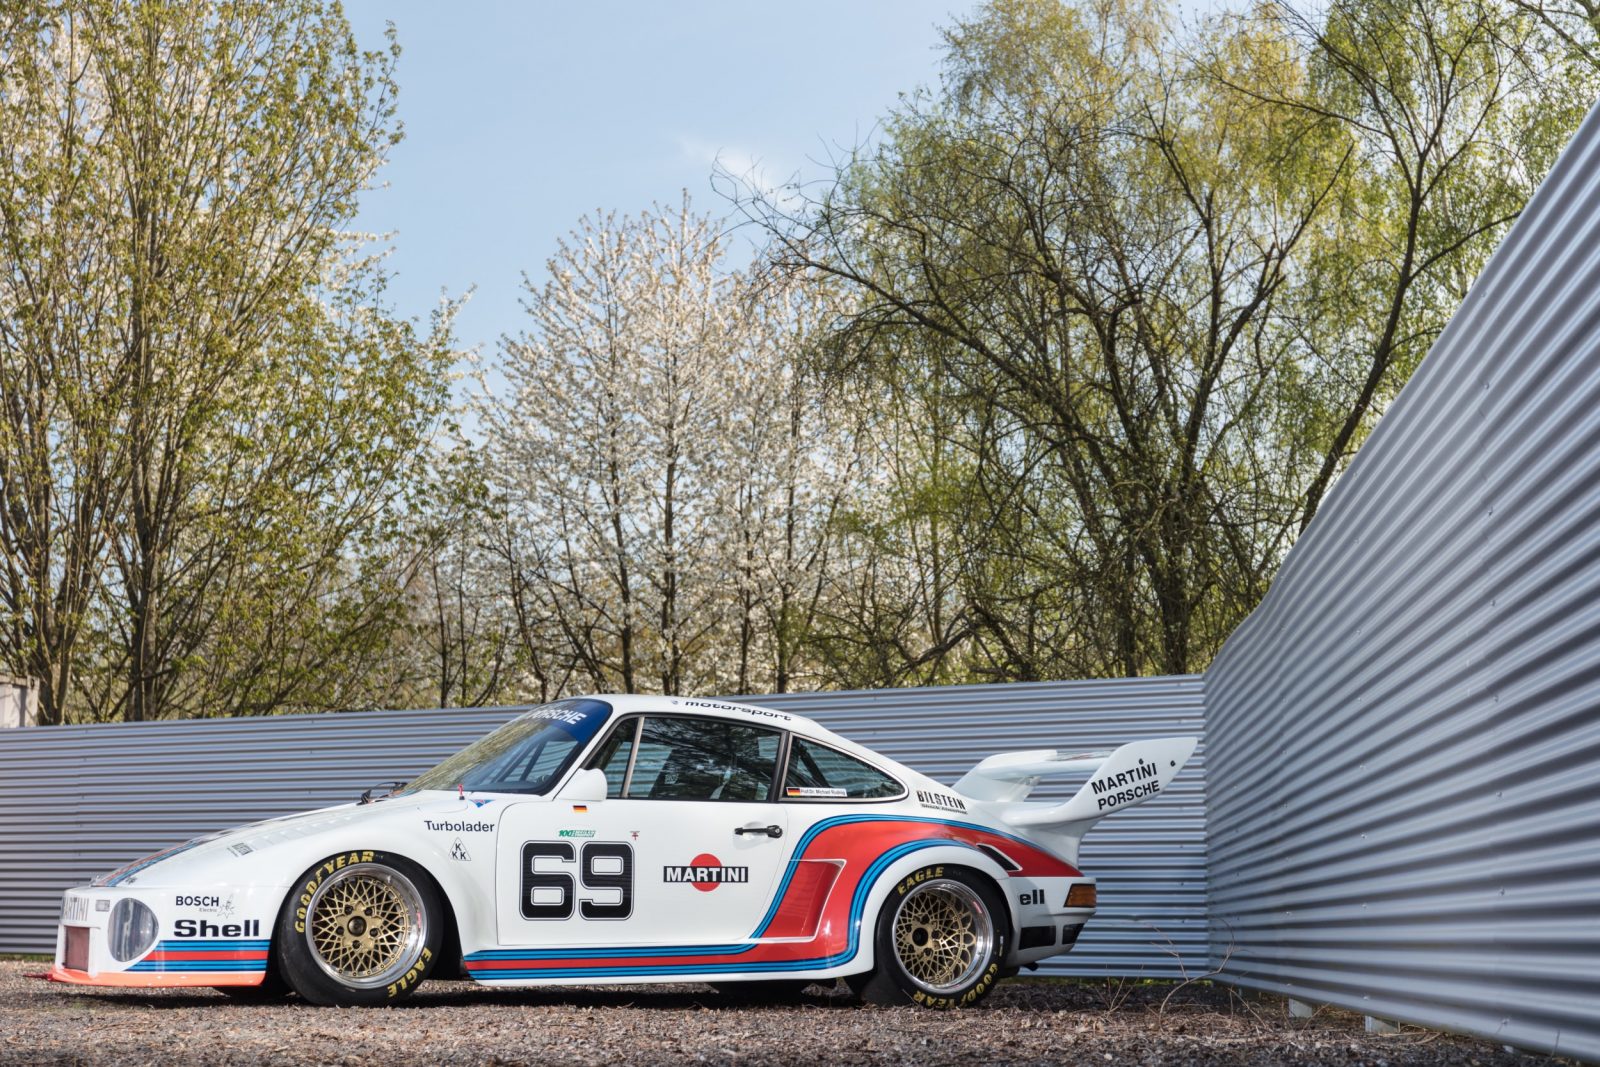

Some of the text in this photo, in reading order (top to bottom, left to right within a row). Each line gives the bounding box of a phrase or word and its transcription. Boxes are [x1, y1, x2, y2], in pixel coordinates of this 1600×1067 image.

[685, 700, 792, 721] motorsport
[1090, 762, 1158, 795] MARTINI
[916, 790, 966, 810] BILSTEIN
[1097, 780, 1160, 811] PORSCHE
[424, 820, 495, 832] Turbolader
[518, 840, 635, 921] 69
[666, 867, 746, 882] MARTINI
[897, 866, 945, 896] EAGLE
[175, 895, 220, 907] BOSCH
[294, 851, 375, 933] GOODYEAR
[173, 919, 259, 938] Shell
[387, 947, 433, 998] EAGLE
